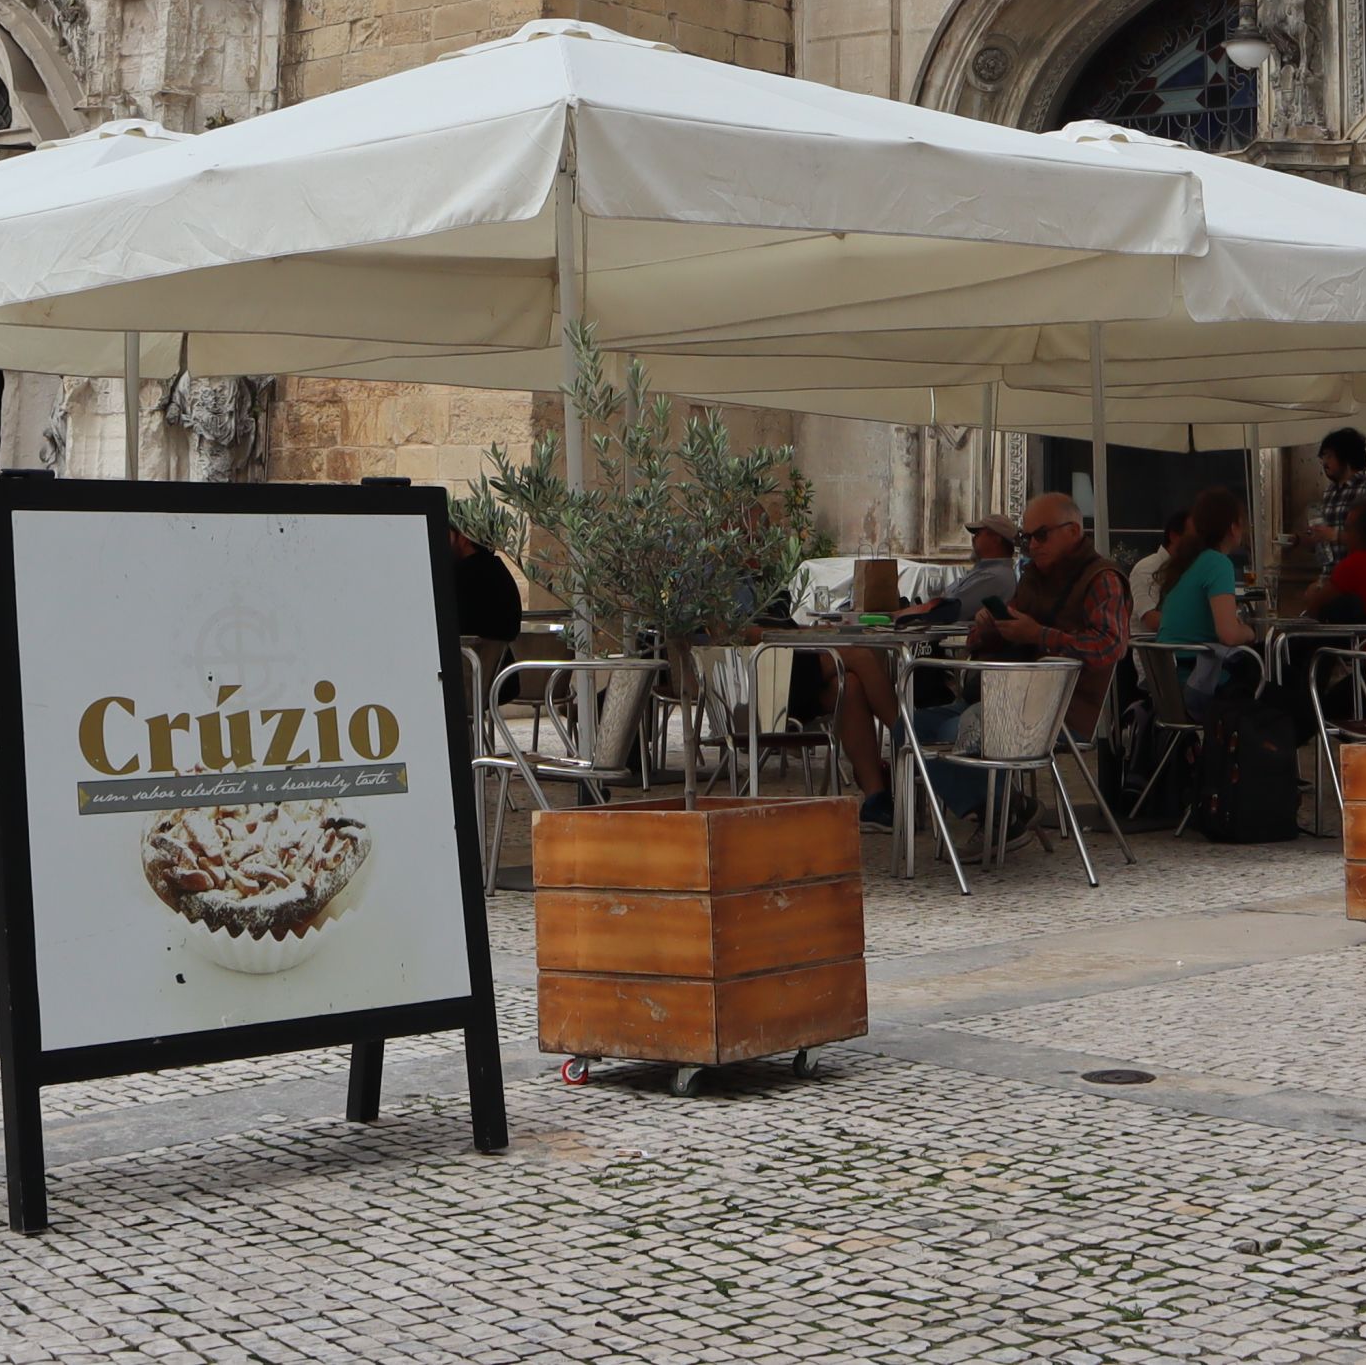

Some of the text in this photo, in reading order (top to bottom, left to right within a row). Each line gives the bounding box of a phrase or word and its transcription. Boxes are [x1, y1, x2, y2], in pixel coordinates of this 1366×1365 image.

[78, 680, 400, 776] Crúzio
[132, 787, 176, 802] sabor
[181, 780, 245, 798] celestial
[281, 773, 351, 795] heavenly
[355, 771, 392, 785] taste
